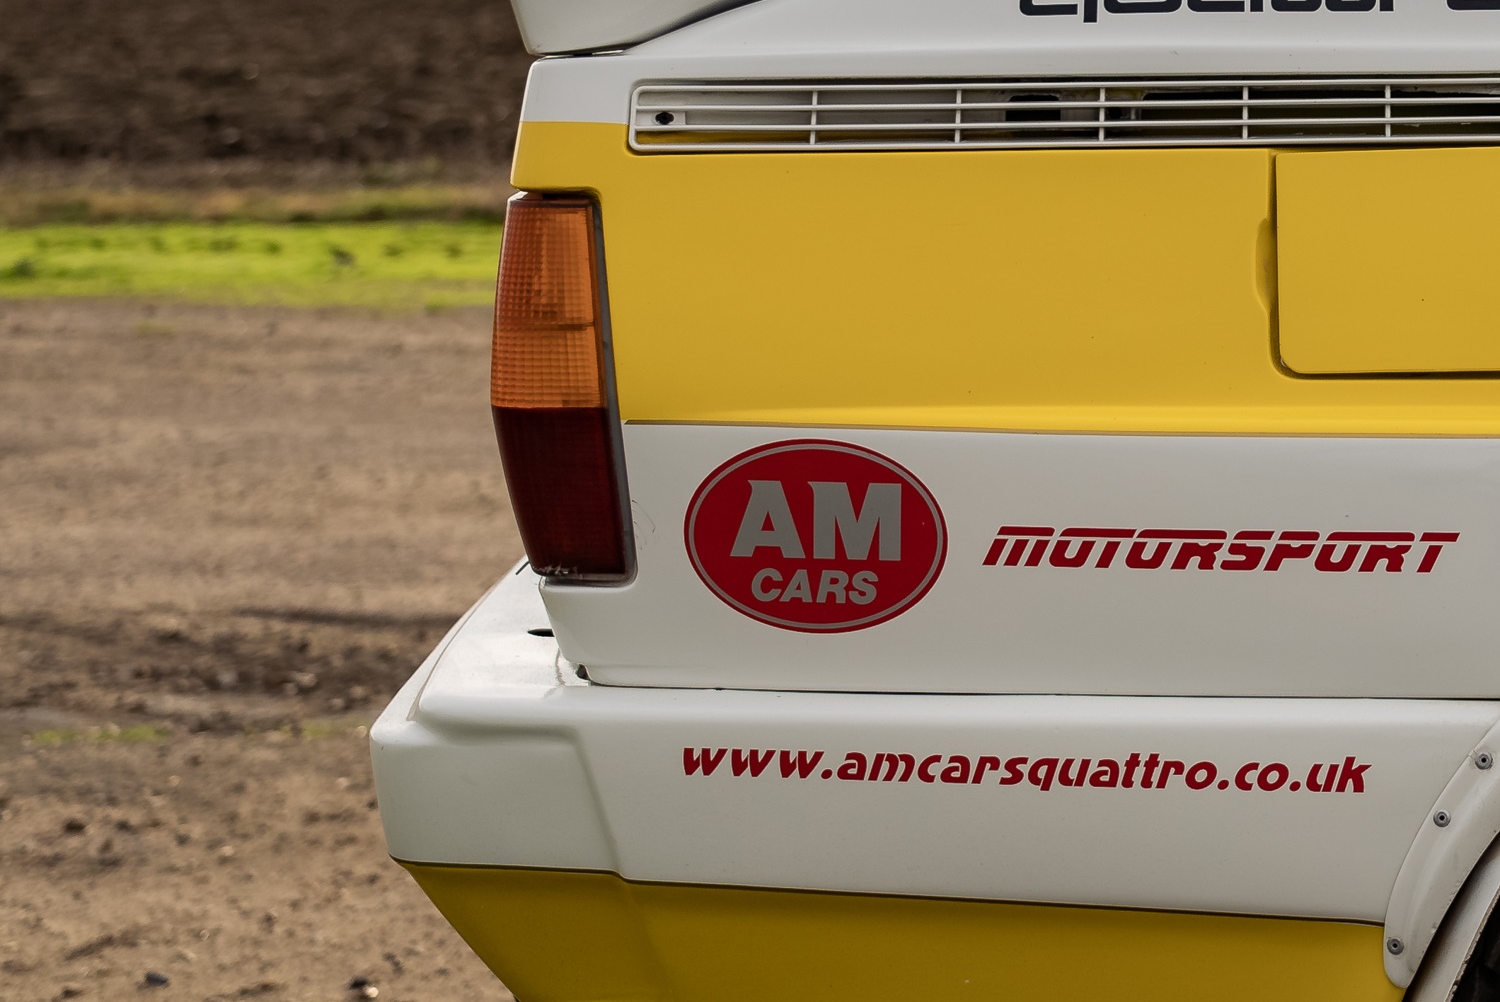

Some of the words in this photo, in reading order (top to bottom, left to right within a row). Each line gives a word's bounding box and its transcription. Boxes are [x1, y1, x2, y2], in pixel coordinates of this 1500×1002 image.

[730, 480, 902, 561] AM
[982, 526, 1461, 574] MOTORSPORT
[750, 566, 878, 605] CARS
[682, 747, 1373, 795] www.amcarsquattro.co.uk
